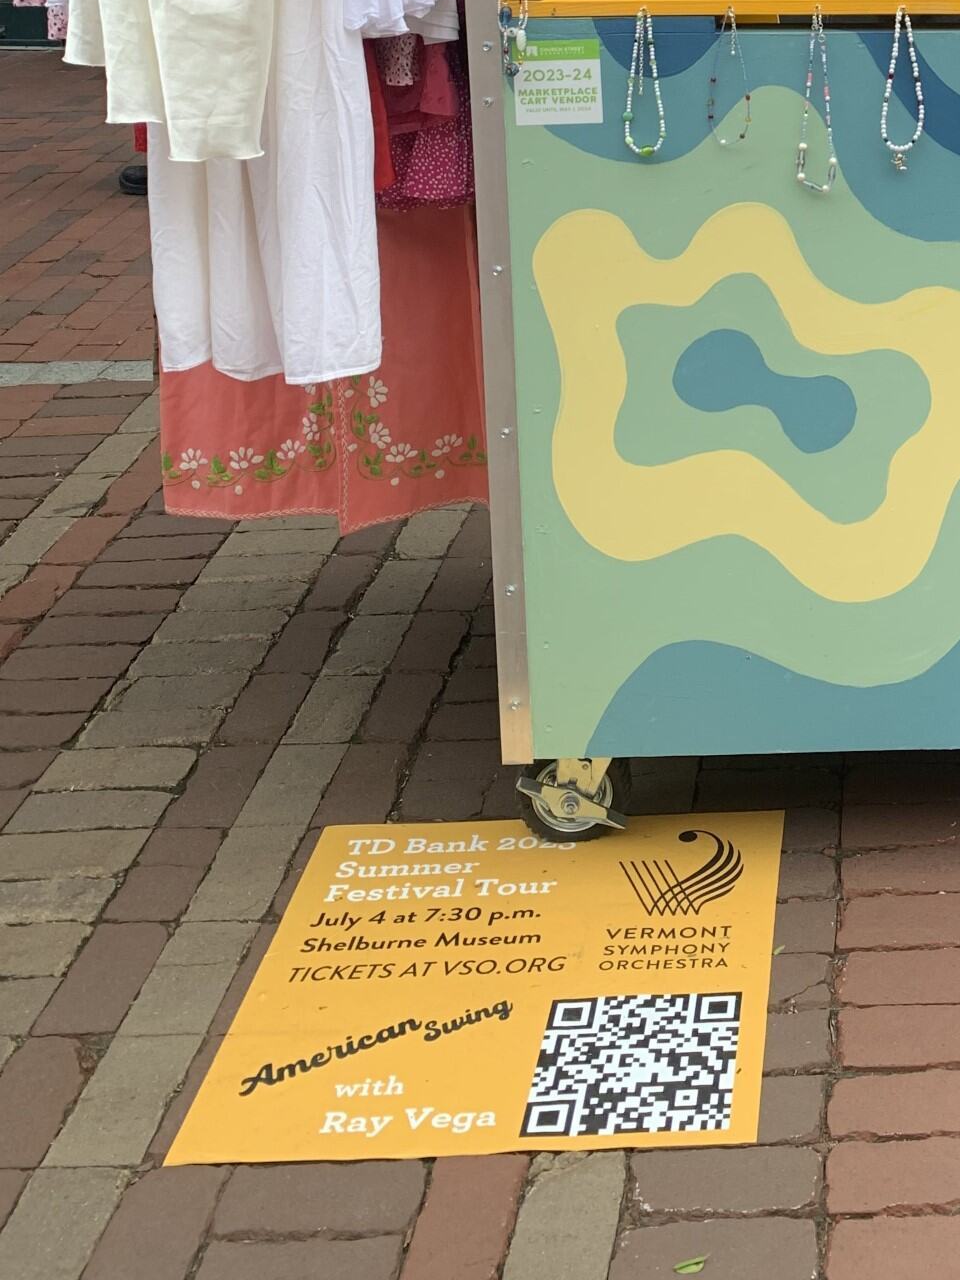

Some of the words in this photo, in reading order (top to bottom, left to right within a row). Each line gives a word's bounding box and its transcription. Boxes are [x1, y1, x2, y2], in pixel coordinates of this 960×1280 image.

[523, 68, 592, 82] 2023-24
[518, 87, 598, 97] MARKETPLACE
[520, 96, 547, 105] CART
[552, 95, 597, 104] VENDOR
[348, 839, 395, 856] TD
[404, 835, 488, 855] Bank
[334, 861, 480, 880] Summer
[323, 878, 466, 903] Festival
[475, 878, 558, 897] Tour
[310, 911, 362, 931] July
[368, 910, 387, 925] 4
[393, 912, 417, 924] at
[424, 907, 482, 923] 7:30
[488, 907, 542, 926] p.m.
[299, 936, 428, 953] Shelburne
[434, 932, 542, 948] Museum
[606, 925, 733, 940] VERMONT
[603, 942, 731, 956] SYMPHONY
[288, 963, 396, 984] TICKETS
[398, 961, 438, 978] AT
[443, 956, 568, 977] VSO.ORG
[599, 957, 729, 971] ORCHESTRA
[238, 1018, 422, 1097] American
[422, 999, 514, 1042] Swing
[335, 1075, 405, 1098] with
[319, 1111, 394, 1138] Ray
[404, 1106, 497, 1133] Vega
